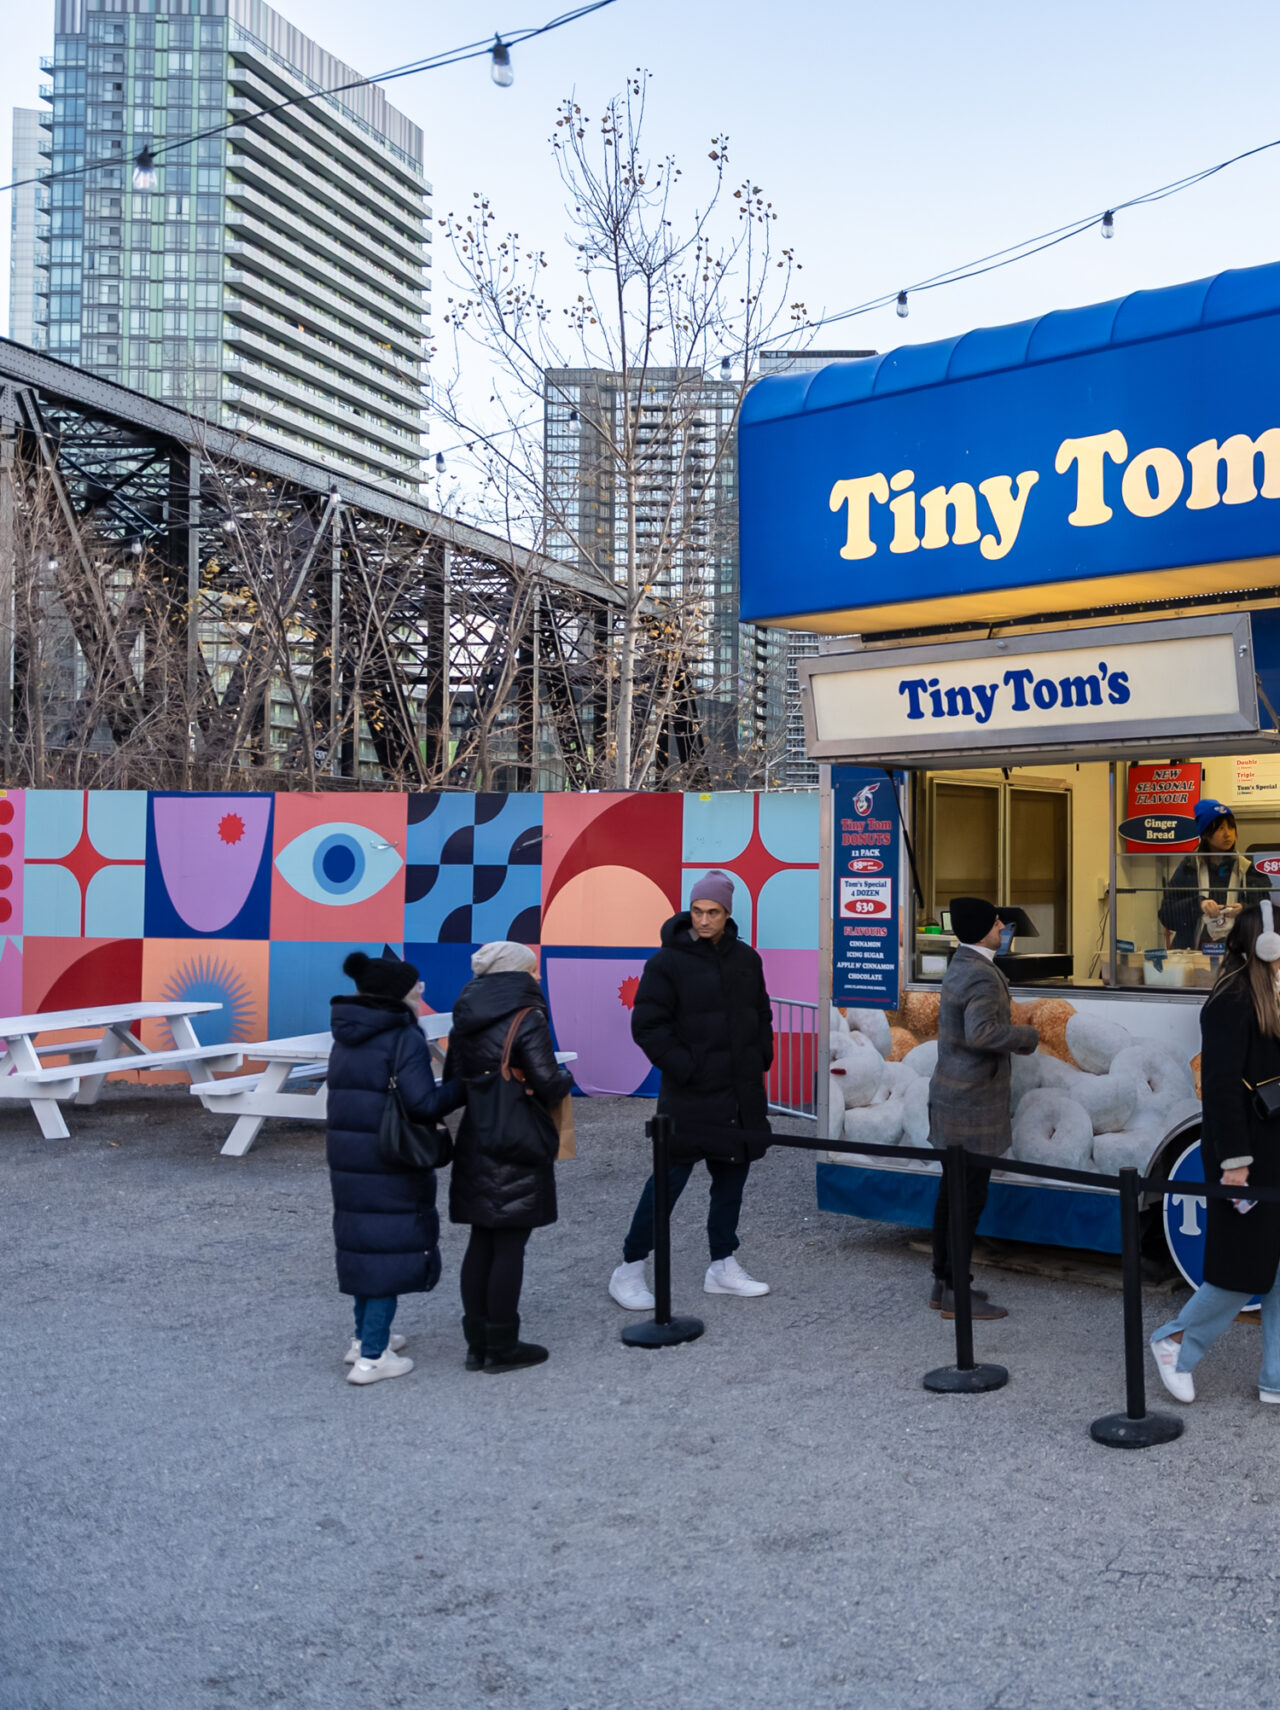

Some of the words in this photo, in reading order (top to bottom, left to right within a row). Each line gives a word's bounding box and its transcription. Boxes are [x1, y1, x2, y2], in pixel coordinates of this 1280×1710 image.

[829, 469, 1039, 561] Tiny
[900, 669, 1000, 725] Tiny
[1003, 661, 1131, 712] Tom's
[1152, 769, 1182, 780] NEW
[1135, 780, 1195, 793] SEASONAL
[1256, 783, 1277, 791] Special
[1135, 793, 1189, 805] FLAVOUR
[841, 818, 865, 832] Tiny
[867, 818, 892, 830] Tom
[1144, 819, 1178, 829] Ginger
[841, 832, 891, 846] DONUTS
[1146, 830, 1175, 839] Bread
[861, 849, 880, 857] PACK
[864, 881, 887, 889] Special
[856, 889, 880, 897] DOZEN
[855, 901, 875, 913] $30
[843, 926, 888, 937] FLAVOURS
[864, 951, 885, 959] SUGAR
